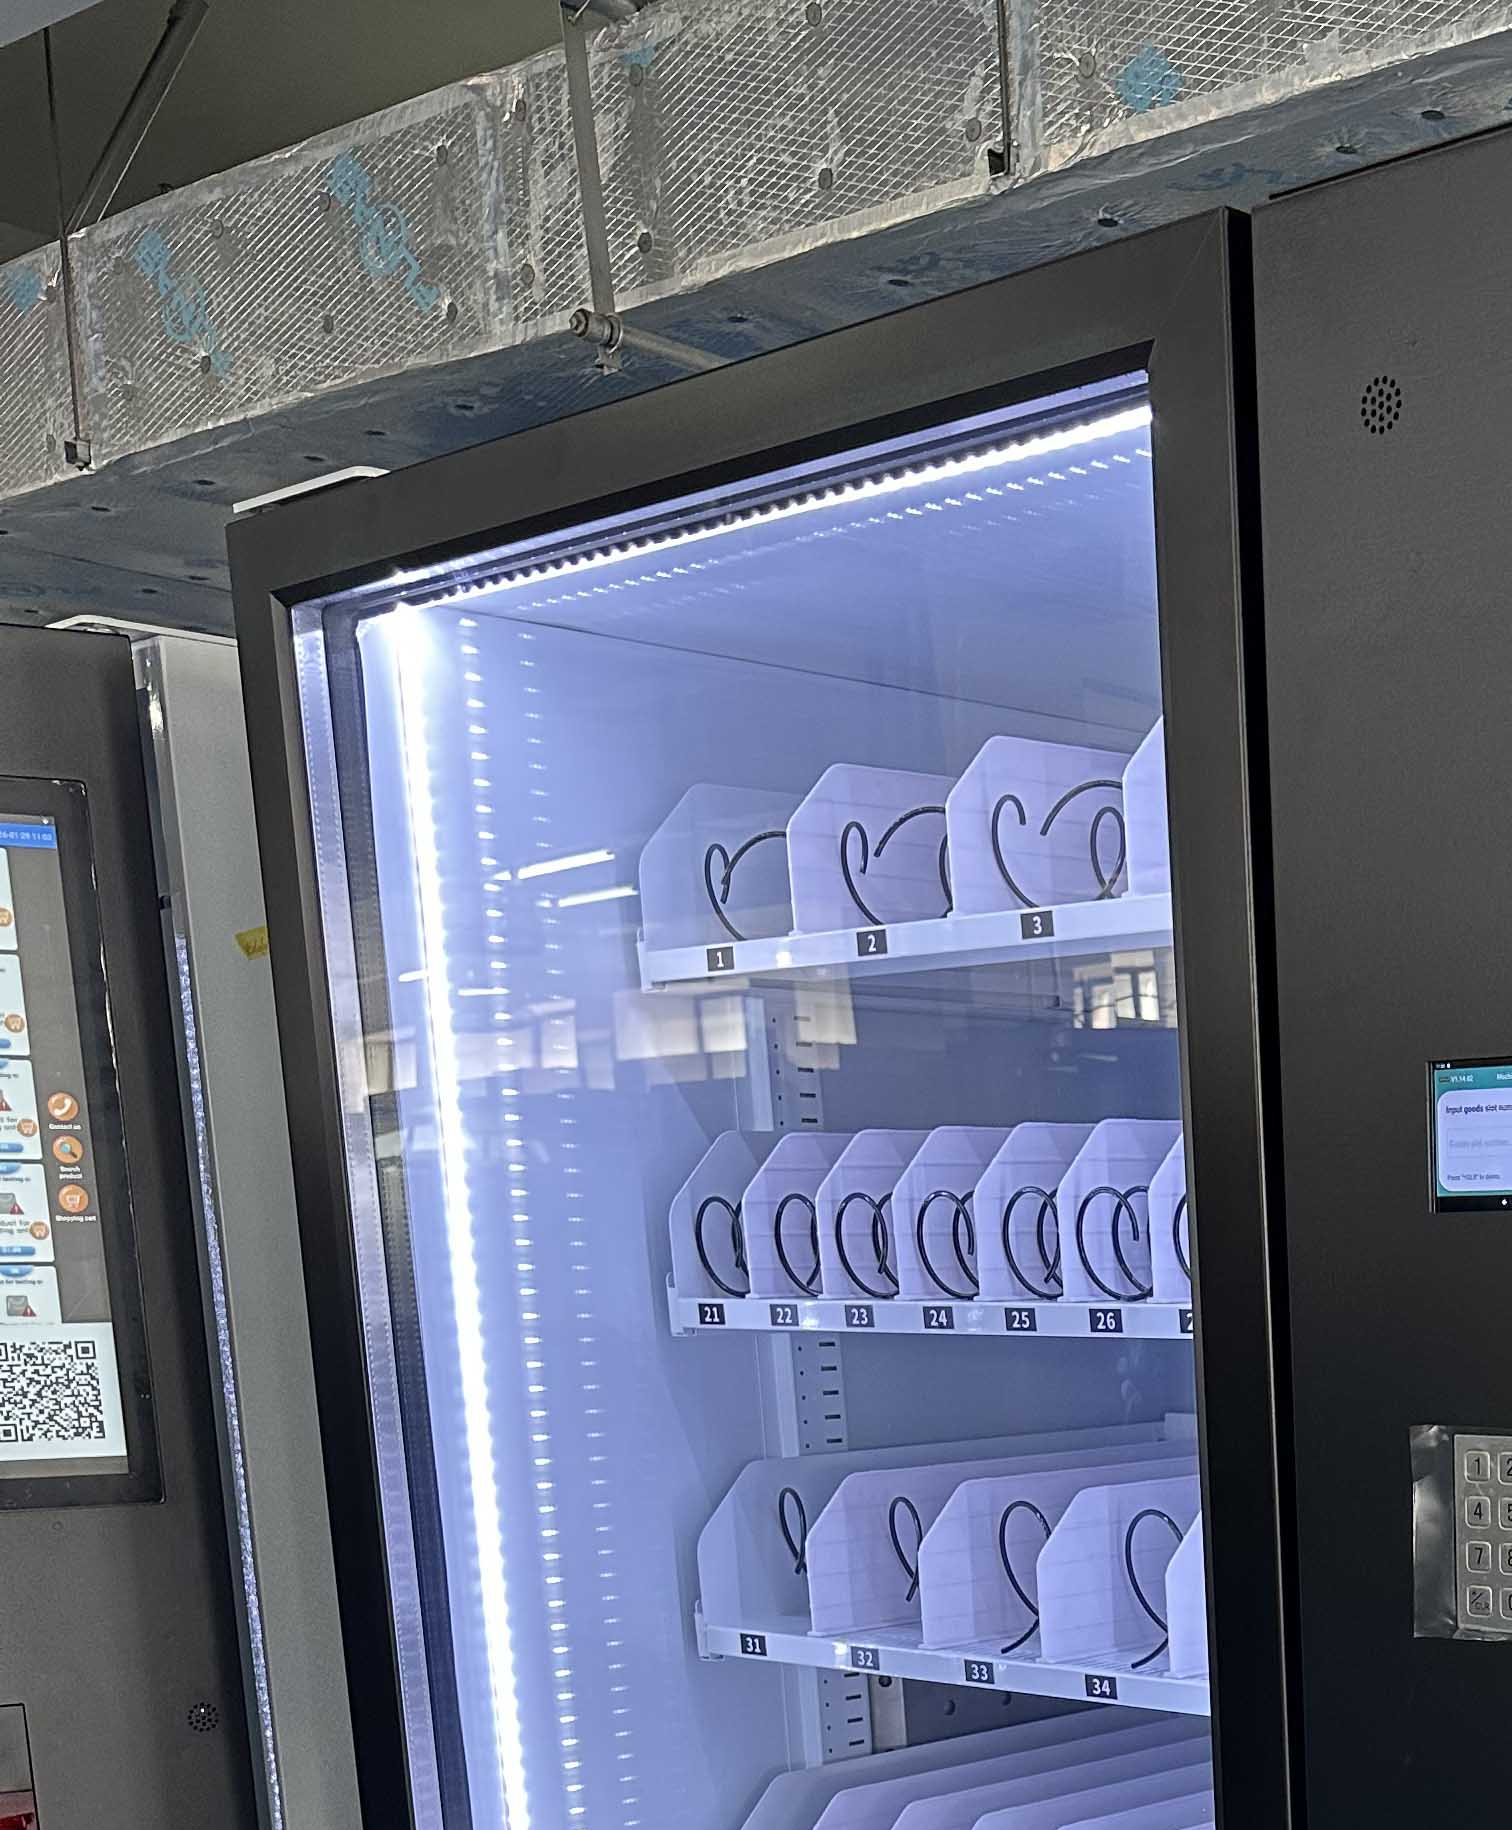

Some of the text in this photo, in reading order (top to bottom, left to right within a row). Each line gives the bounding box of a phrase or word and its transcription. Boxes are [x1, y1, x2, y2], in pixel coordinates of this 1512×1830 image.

[1031, 916, 1044, 935] 3
[866, 934, 879, 952] 2
[715, 950, 726, 969] 1
[1464, 1104, 1483, 1115] goods
[703, 1306, 721, 1324] 21
[775, 1307, 793, 1325] 22
[851, 1308, 869, 1326] 23
[929, 1309, 948, 1327] 24
[1011, 1310, 1030, 1329] 25
[1095, 1311, 1116, 1330] 26
[1474, 1457, 1482, 1476] 1
[1473, 1503, 1483, 1521] 4
[1474, 1546, 1483, 1564] 7
[744, 1636, 1111, 1696] 31 32 33 34
